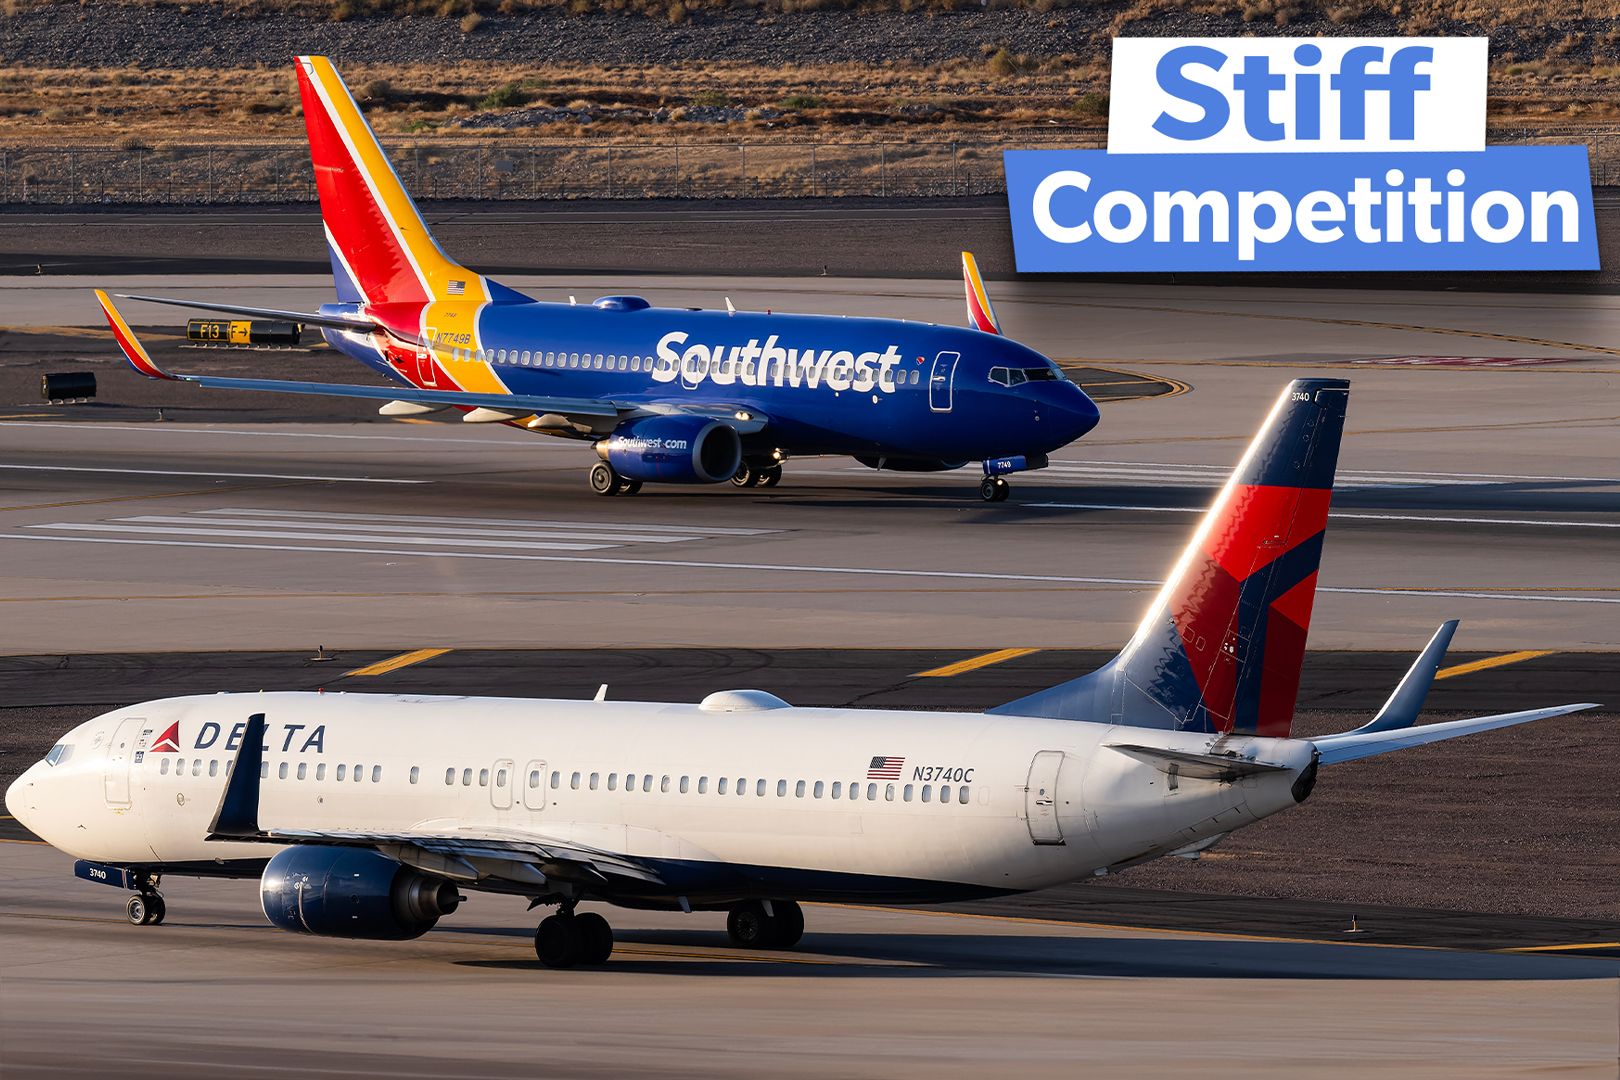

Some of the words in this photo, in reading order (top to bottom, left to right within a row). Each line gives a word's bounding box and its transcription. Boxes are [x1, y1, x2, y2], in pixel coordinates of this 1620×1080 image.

[201, 324, 219, 338] F13
[231, 325, 238, 338] F
[436, 332, 471, 345] N7749B
[652, 331, 902, 393] Southwest
[1291, 392, 1310, 402] 3740
[997, 461, 1011, 469] 7749
[912, 766, 974, 782] N3740C
[89, 867, 107, 880] 3740
